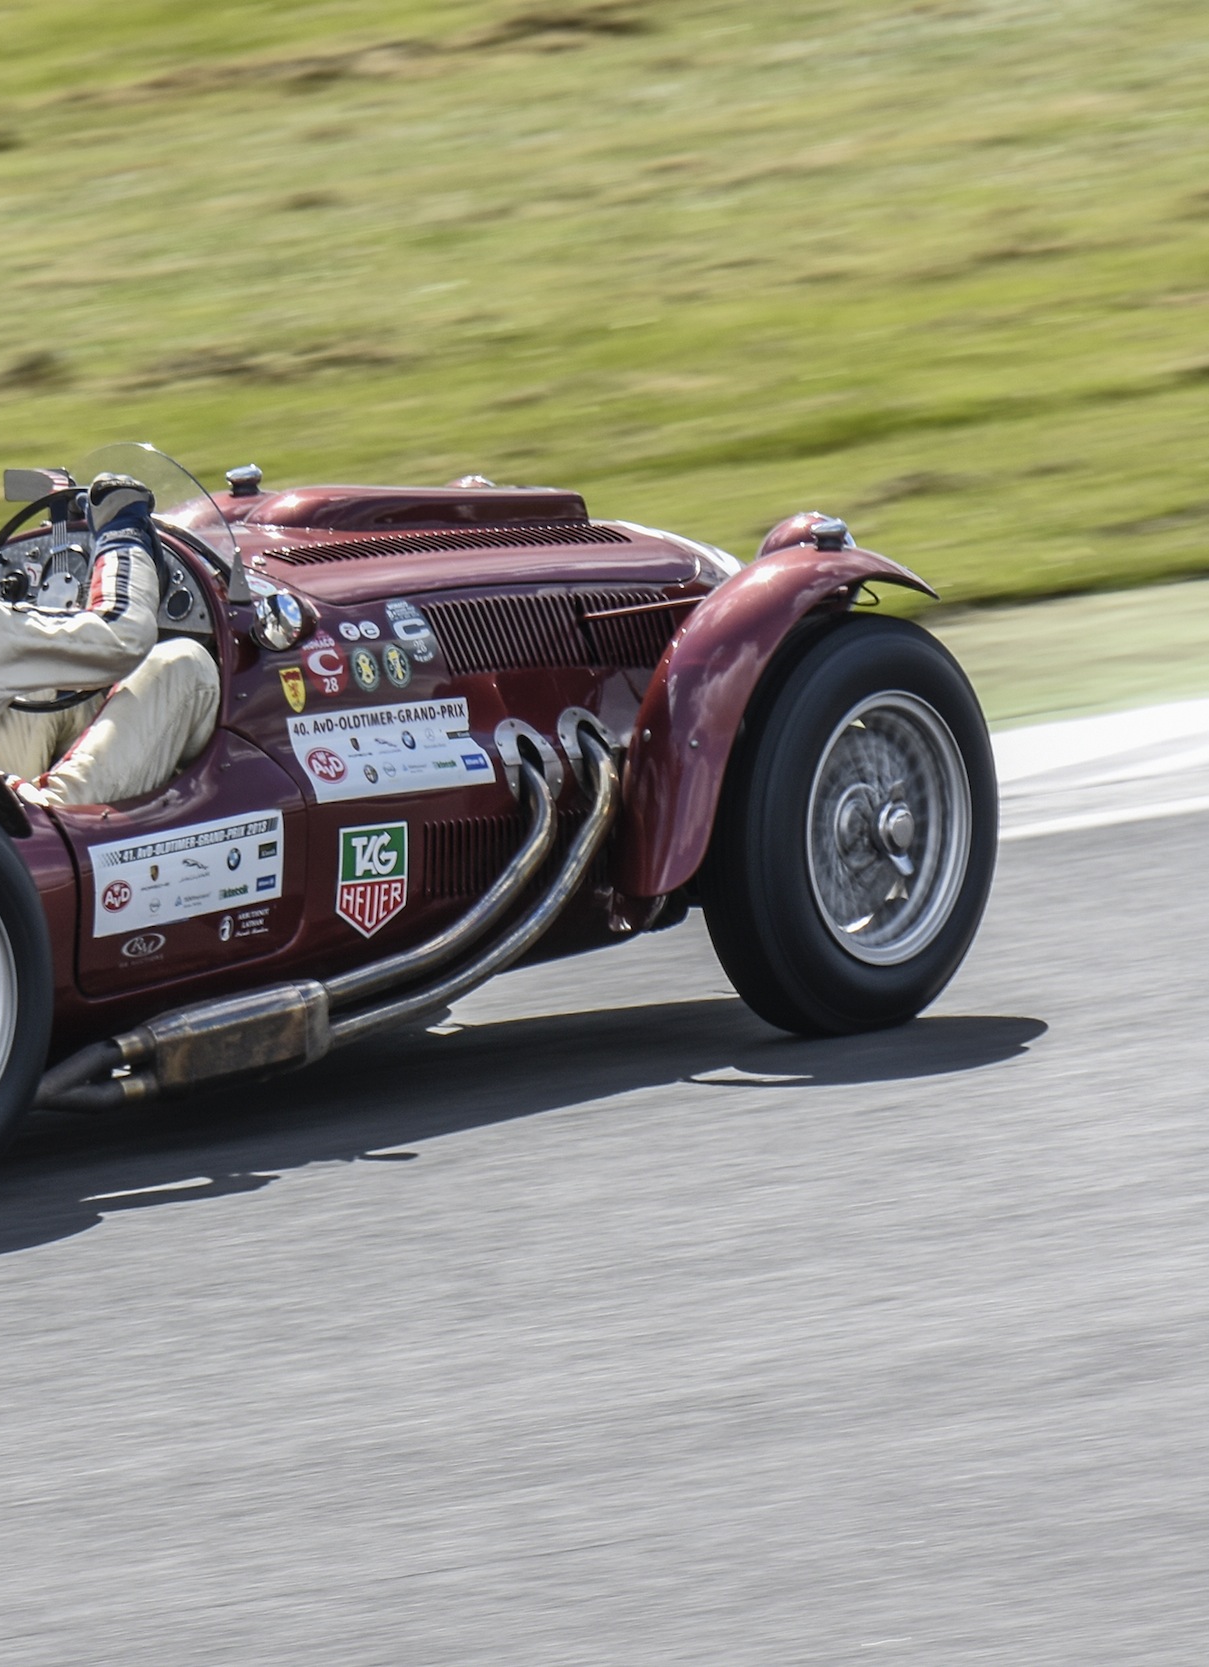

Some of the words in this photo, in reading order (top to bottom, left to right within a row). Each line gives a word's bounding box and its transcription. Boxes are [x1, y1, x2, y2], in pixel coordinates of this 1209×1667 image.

[393, 618, 431, 641] C
[307, 649, 344, 677] C
[322, 677, 340, 694] 28
[293, 722, 310, 737] 40.
[313, 703, 465, 732] AvD-OLDTIMER-GRAND-PRIX
[312, 756, 345, 778] AvD
[122, 849, 137, 862] 41.
[351, 831, 398, 876] TAG
[104, 888, 132, 908] AvD
[342, 882, 402, 928] HEUER
